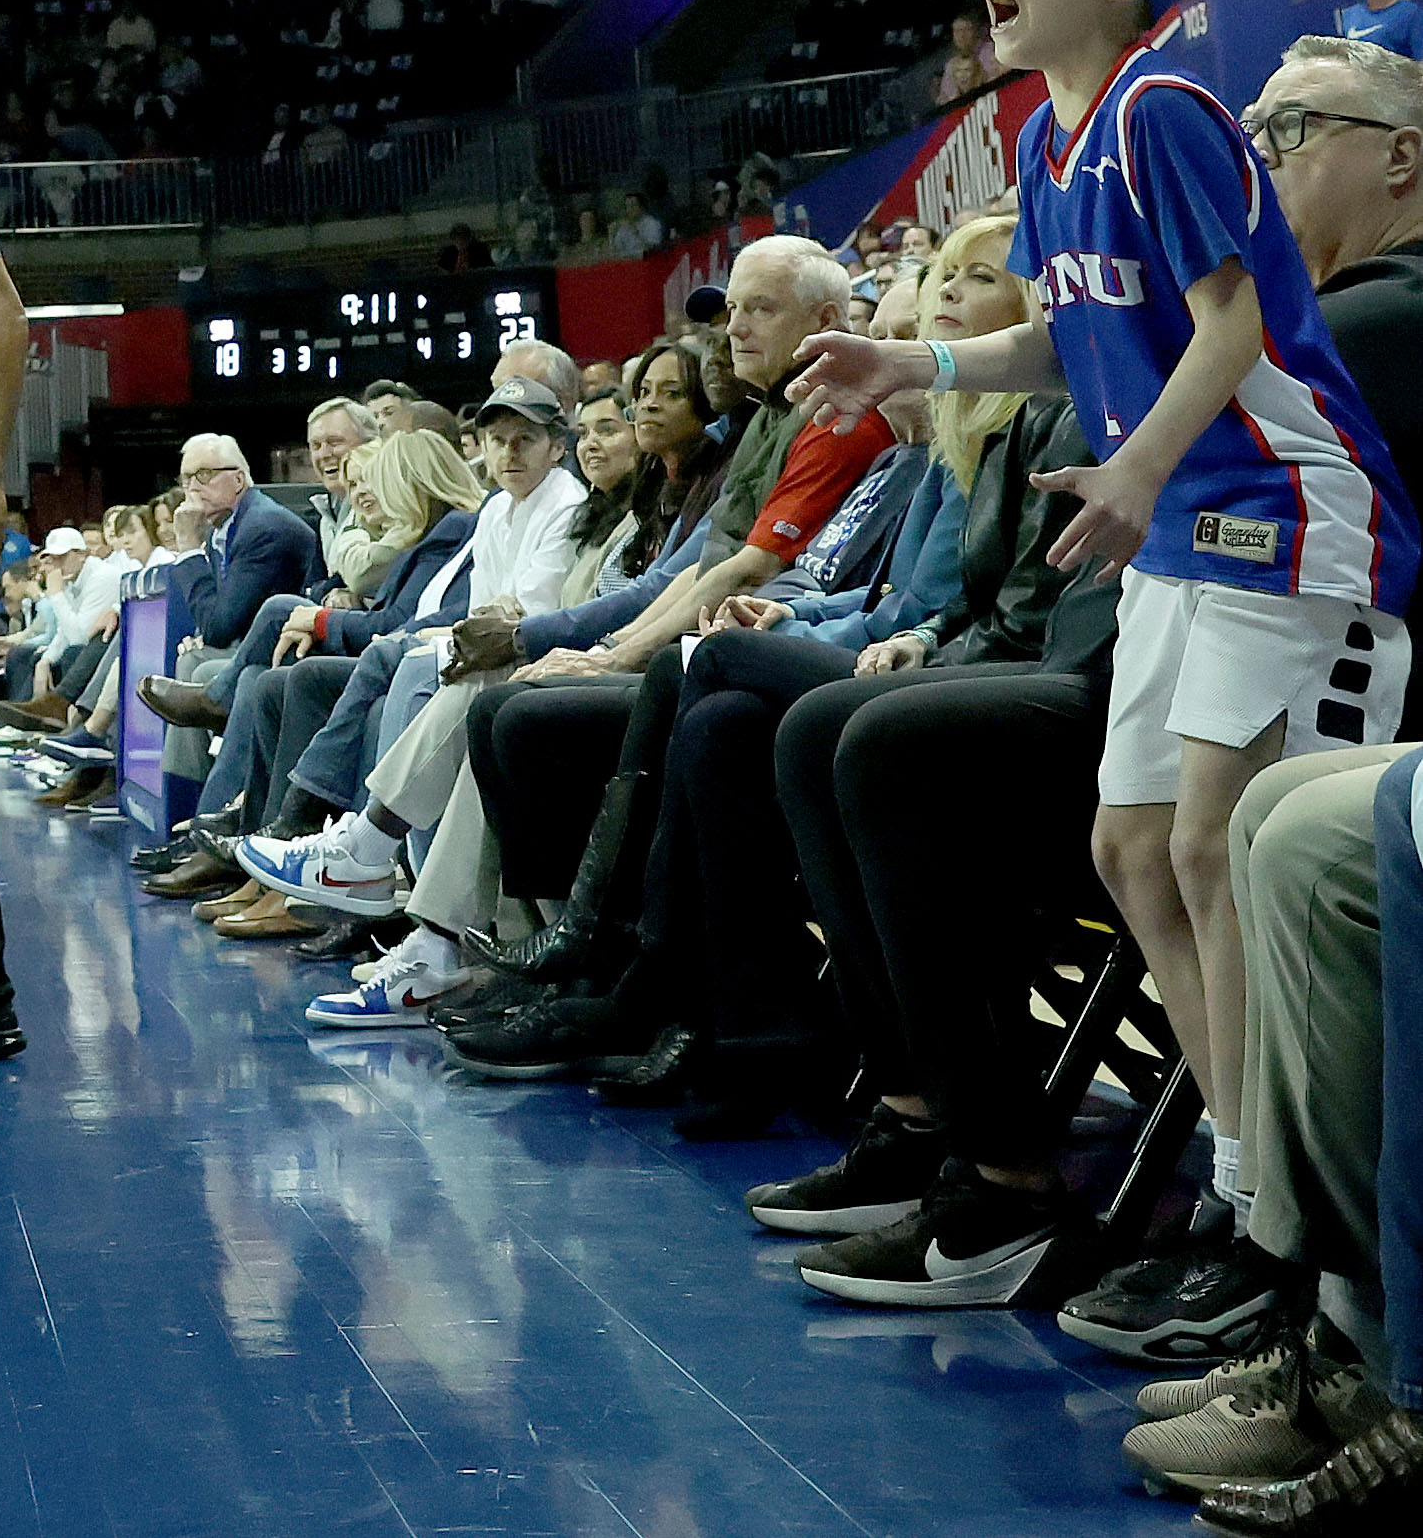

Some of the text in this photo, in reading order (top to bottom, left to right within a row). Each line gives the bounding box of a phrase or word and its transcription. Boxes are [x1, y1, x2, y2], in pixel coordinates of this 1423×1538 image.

[1182, 2, 1208, 39] 103
[341, 293, 396, 325] 9:11
[216, 343, 338, 379] 18 3 3 1
[417, 338, 432, 360] 4
[458, 333, 471, 359] 3
